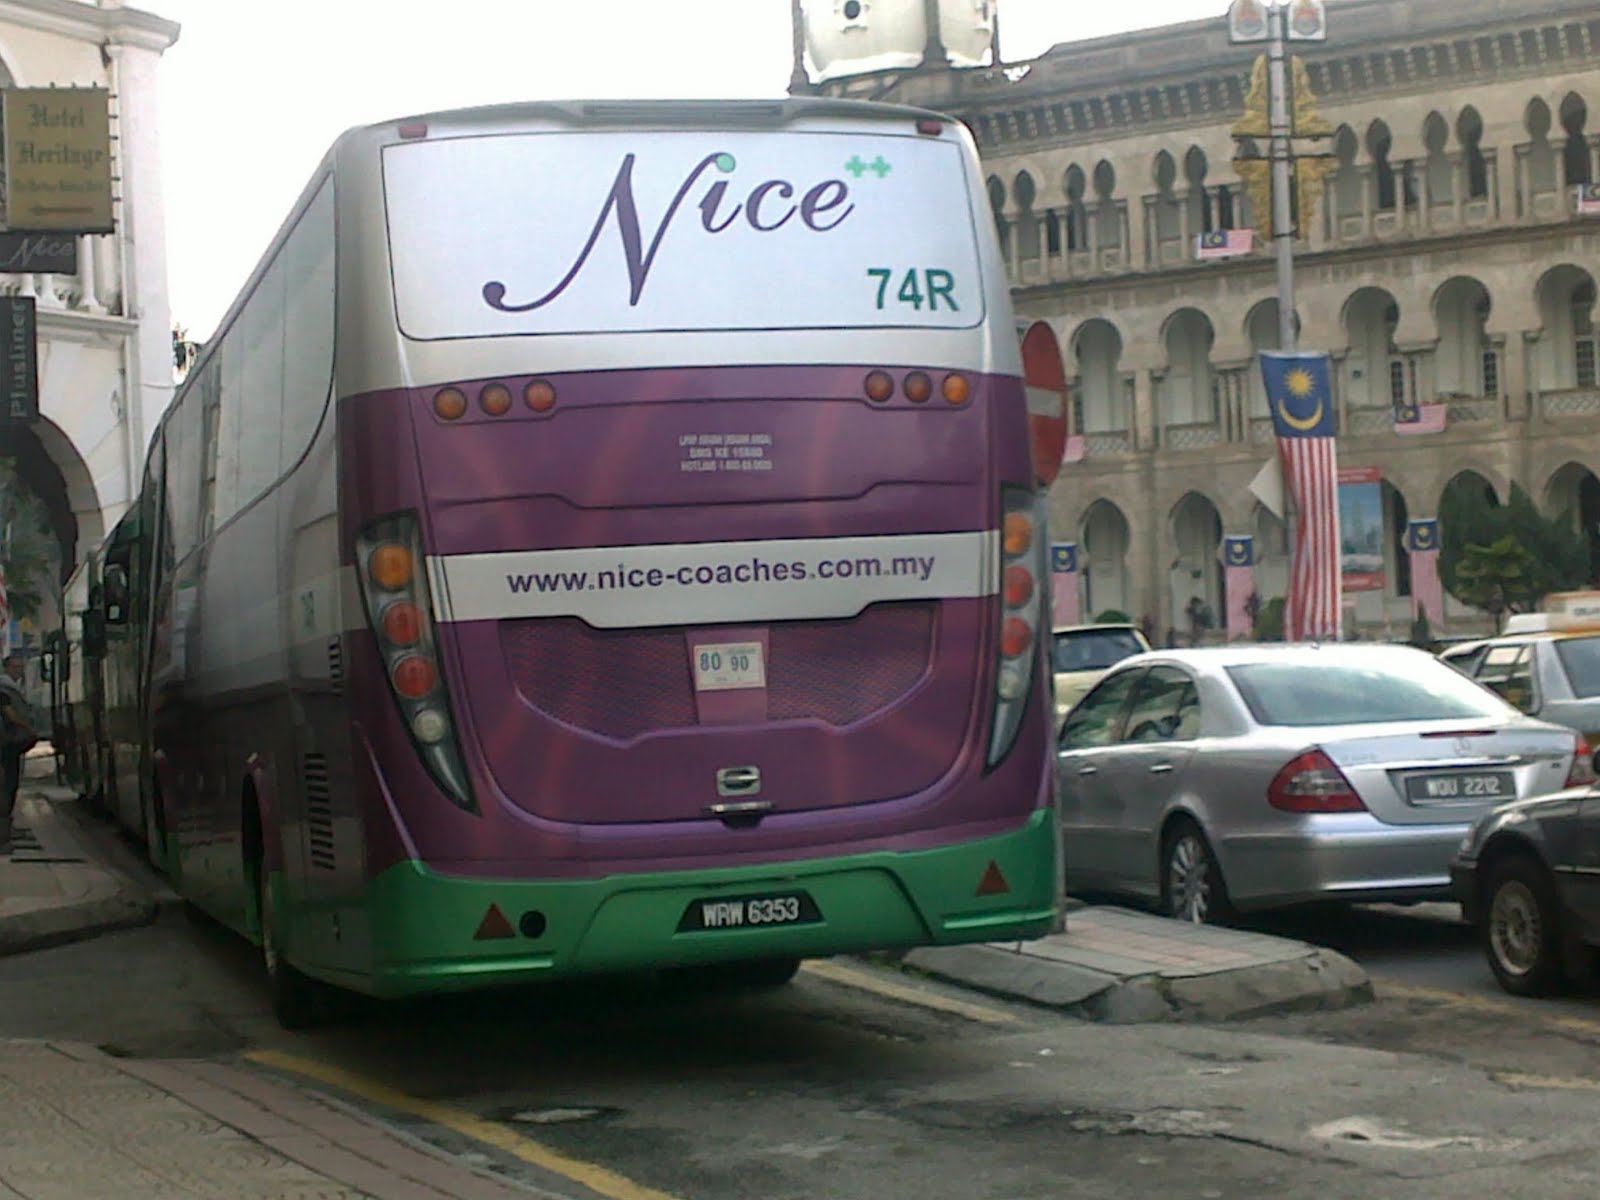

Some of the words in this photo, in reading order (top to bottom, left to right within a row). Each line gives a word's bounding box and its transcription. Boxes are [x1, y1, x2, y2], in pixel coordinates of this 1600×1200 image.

[867, 267, 960, 312] 74R
[507, 555, 935, 593] www.nice-coaches.com.my
[700, 651, 721, 672] 80
[730, 655, 749, 672] 90
[702, 901, 744, 927] WRW
[748, 897, 800, 924] 6353
